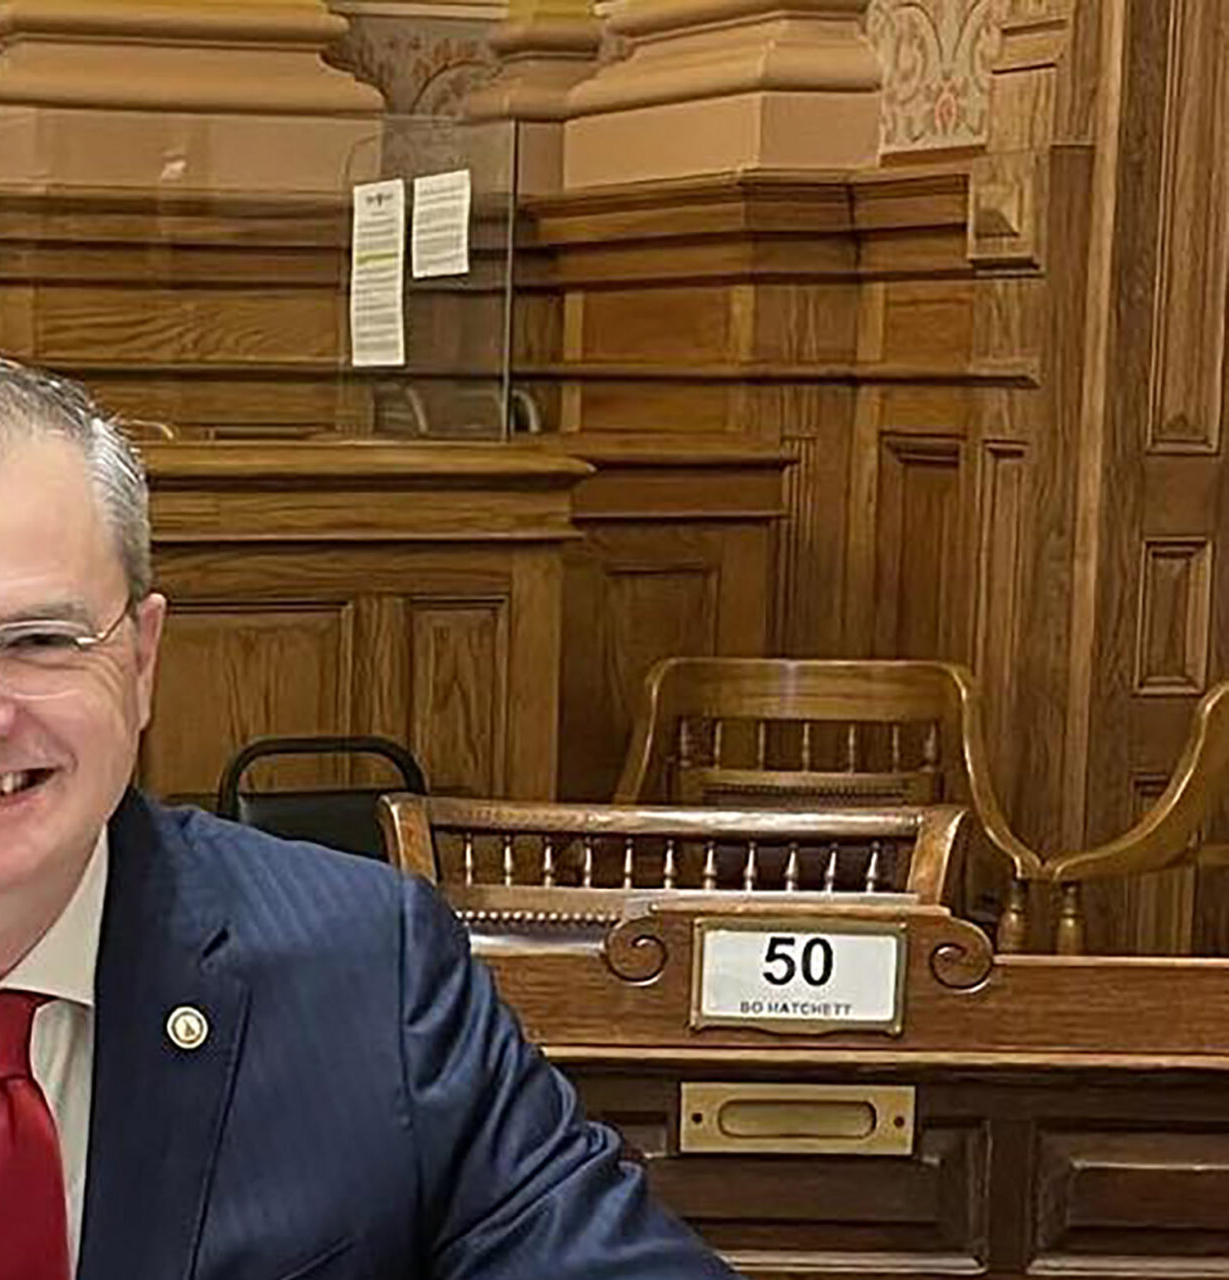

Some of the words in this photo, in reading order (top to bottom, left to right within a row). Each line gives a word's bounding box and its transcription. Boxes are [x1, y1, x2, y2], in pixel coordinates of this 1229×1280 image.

[762, 936, 835, 987] 50
[740, 1001, 763, 1014] BO
[767, 1002, 852, 1016] HATCHETT
